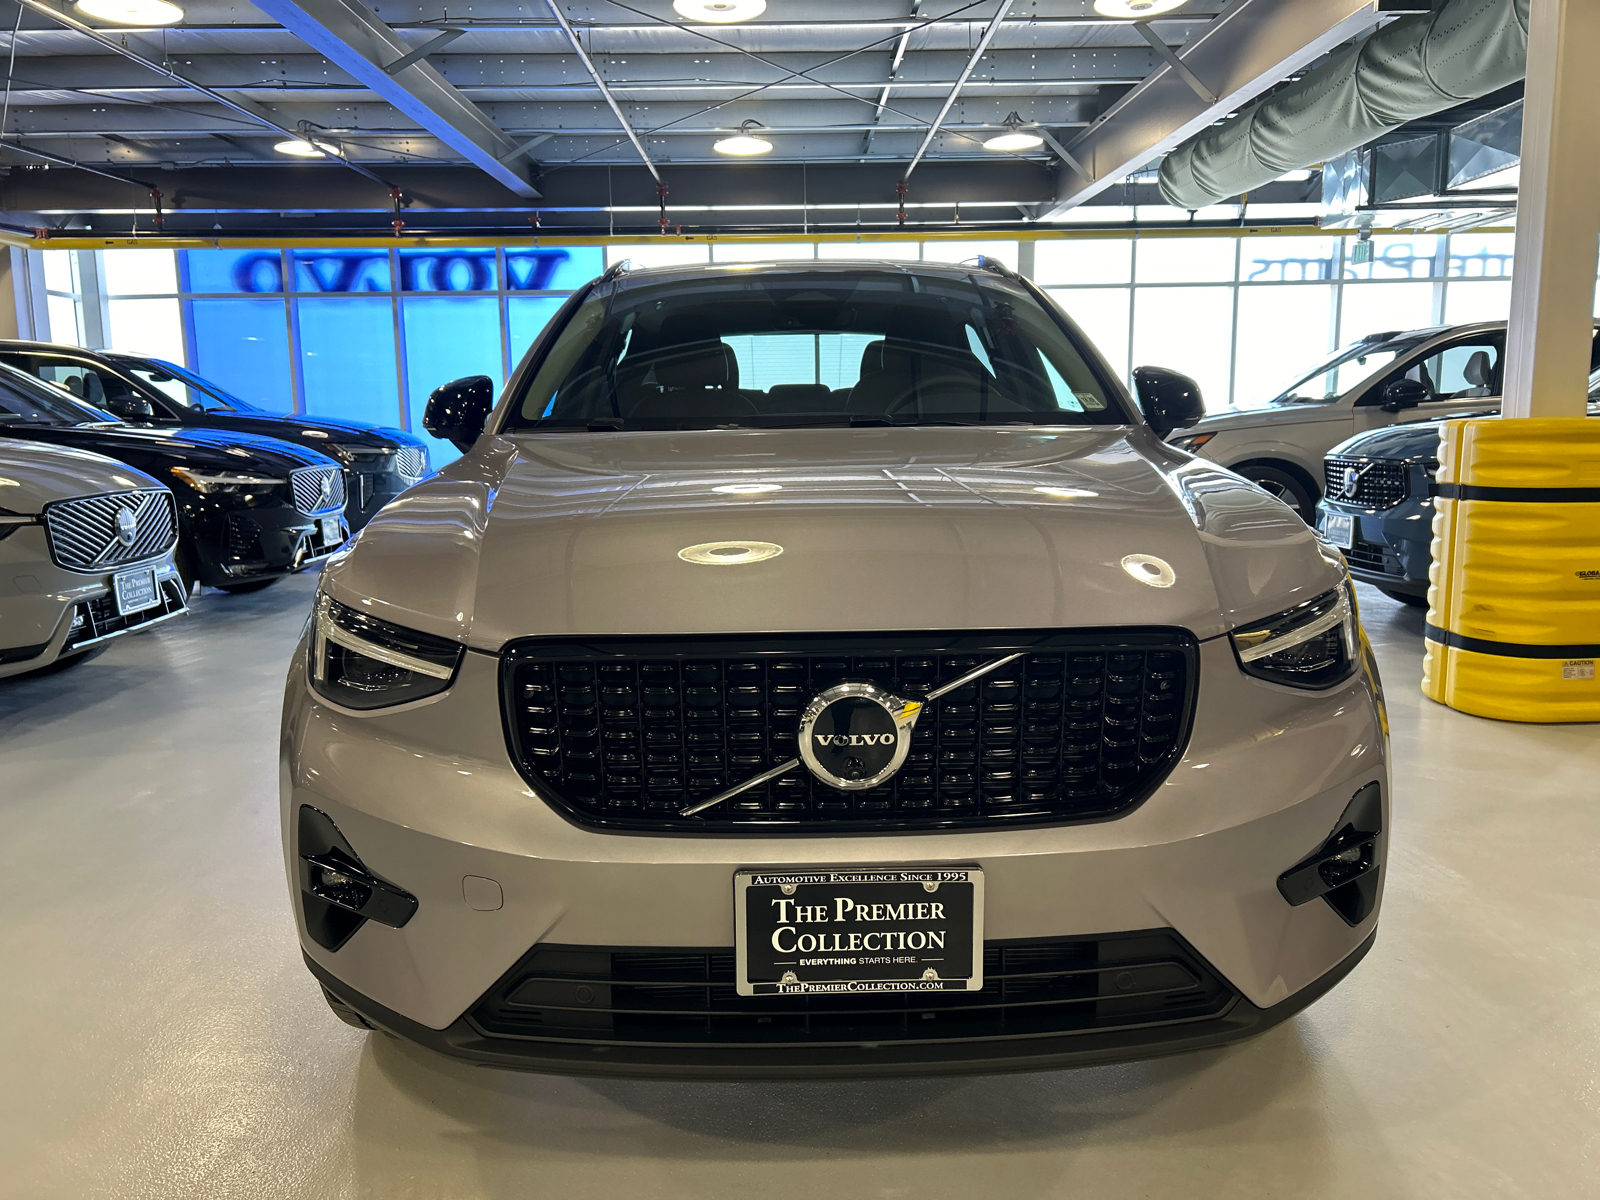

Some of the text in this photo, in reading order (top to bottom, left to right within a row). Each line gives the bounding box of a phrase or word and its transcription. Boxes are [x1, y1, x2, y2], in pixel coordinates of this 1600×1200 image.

[814, 733, 895, 746] VOLVO
[754, 872, 966, 885] AUTOMOTIVE EXCELLENCE SINCE 1995
[771, 897, 946, 924] THE PREMIER
[771, 926, 946, 953] COLLECTION
[800, 958, 857, 966] EVERYTHING
